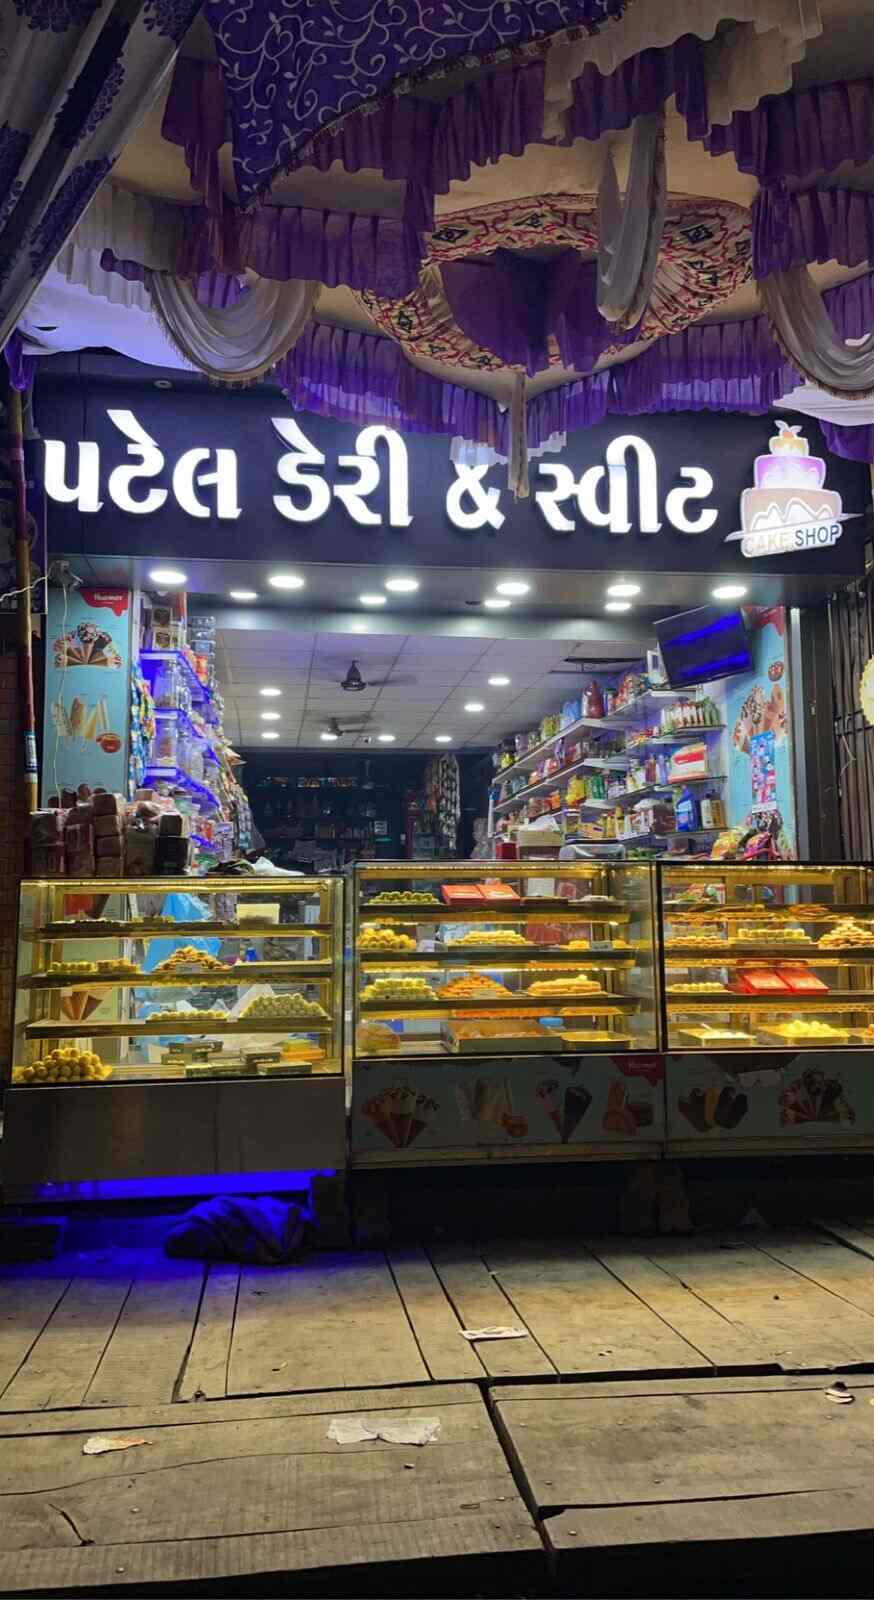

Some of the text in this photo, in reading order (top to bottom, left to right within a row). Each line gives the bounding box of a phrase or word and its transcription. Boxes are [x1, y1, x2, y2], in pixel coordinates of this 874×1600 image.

[44, 409, 718, 534] પટેલ ડેરી & સ્વીટ
[744, 524, 840, 554] CAKE SHOP
